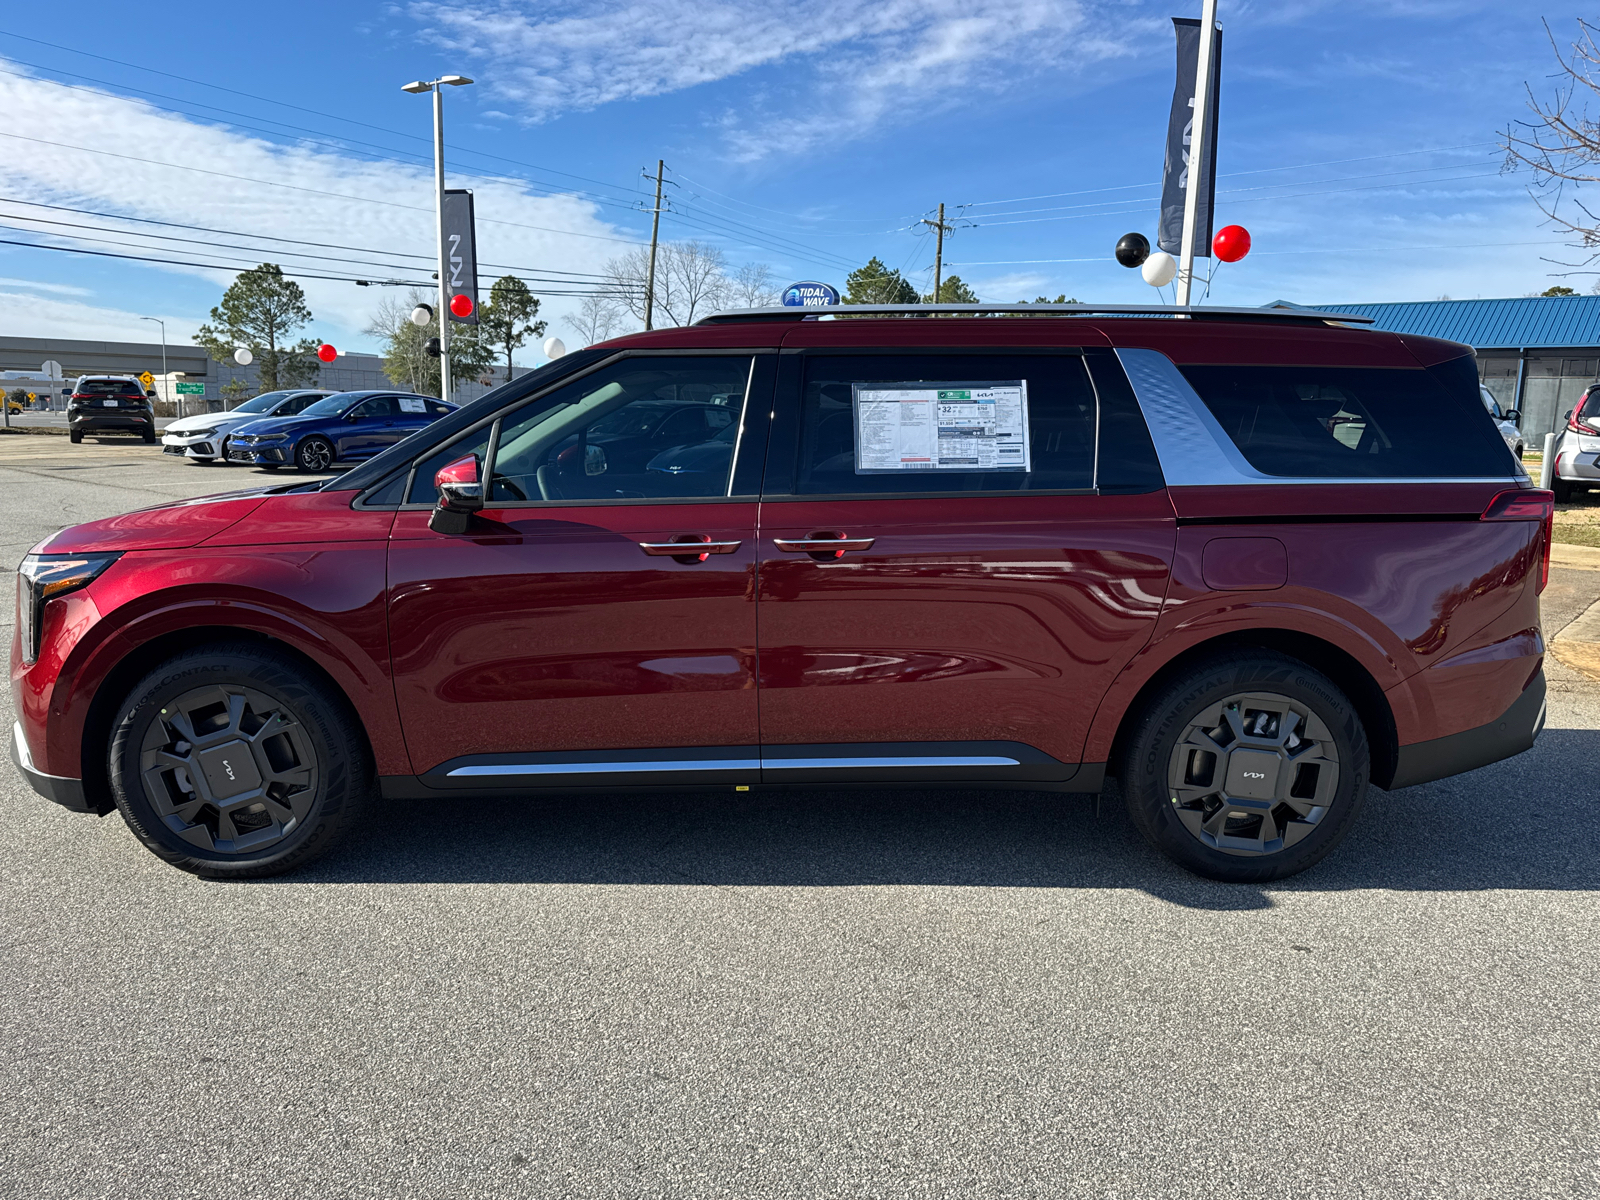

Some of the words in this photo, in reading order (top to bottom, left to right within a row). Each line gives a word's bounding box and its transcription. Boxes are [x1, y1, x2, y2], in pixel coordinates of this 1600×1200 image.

[800, 287, 825, 297] TIDAL
[803, 297, 830, 306] WAVE
[1294, 676, 1340, 710] Continental
[304, 702, 338, 751] Continental
[1146, 676, 1229, 776] CONTINENTAL
